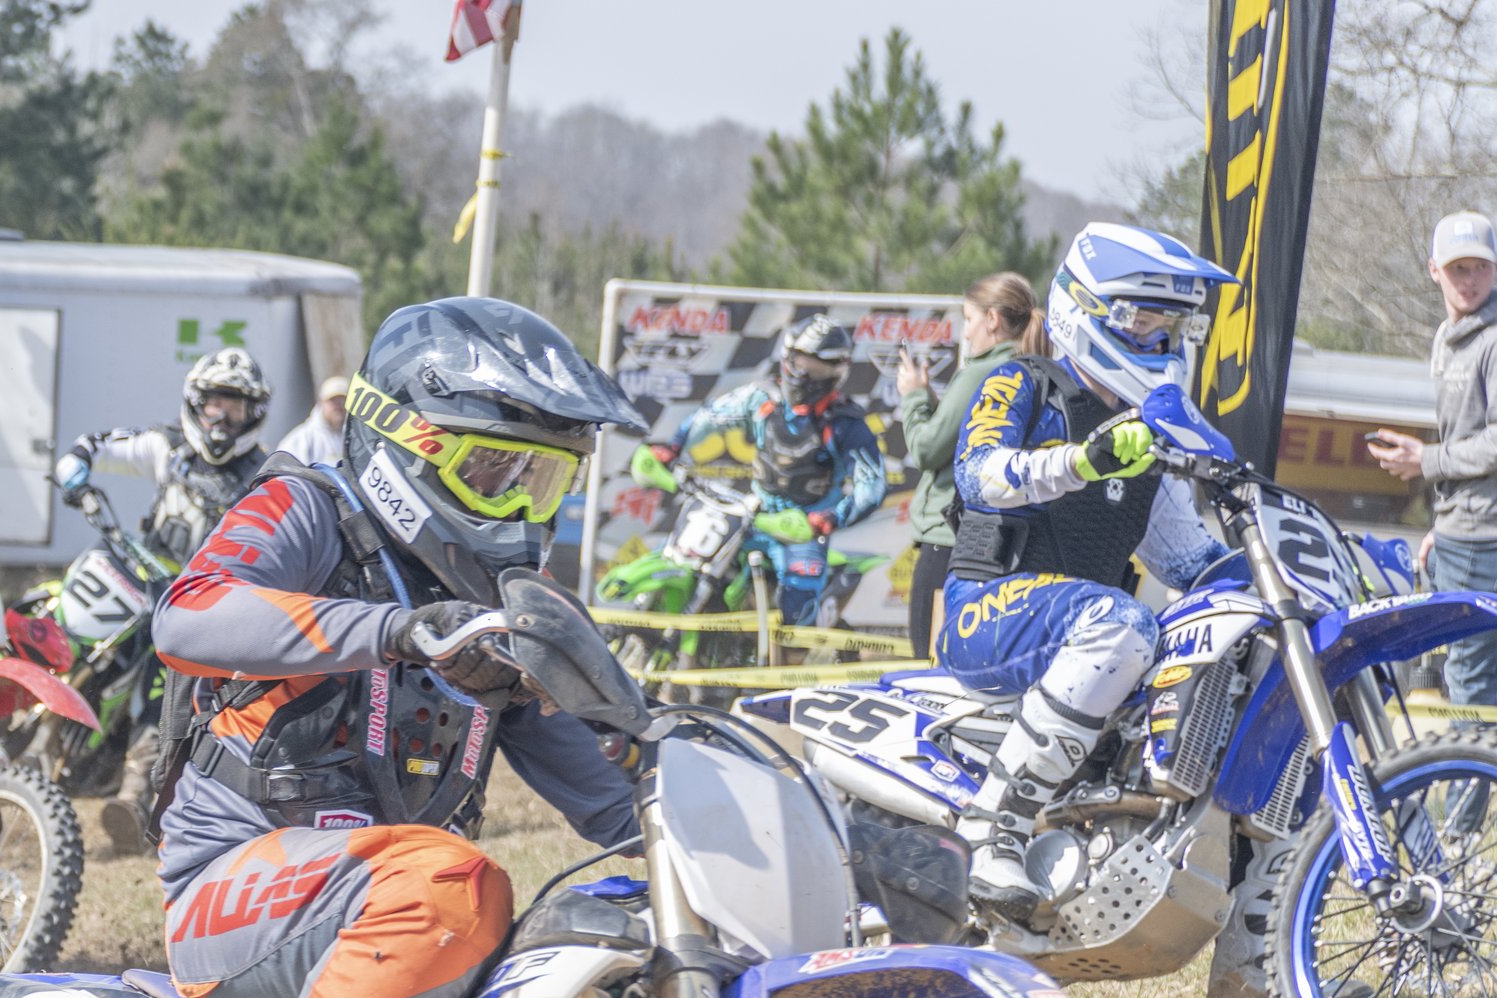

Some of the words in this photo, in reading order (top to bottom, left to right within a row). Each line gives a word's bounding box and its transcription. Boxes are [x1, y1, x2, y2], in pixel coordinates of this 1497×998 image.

[1080, 236, 1096, 260] FOX
[1175, 283, 1191, 293] FOX
[854, 313, 954, 344] KENDA
[352, 386, 449, 456] 100%
[367, 466, 416, 533] 9842
[66, 570, 135, 621] 27
[793, 690, 911, 743] 25
[1347, 763, 1396, 866] DUNLOP
[170, 852, 342, 943] ALIAS
